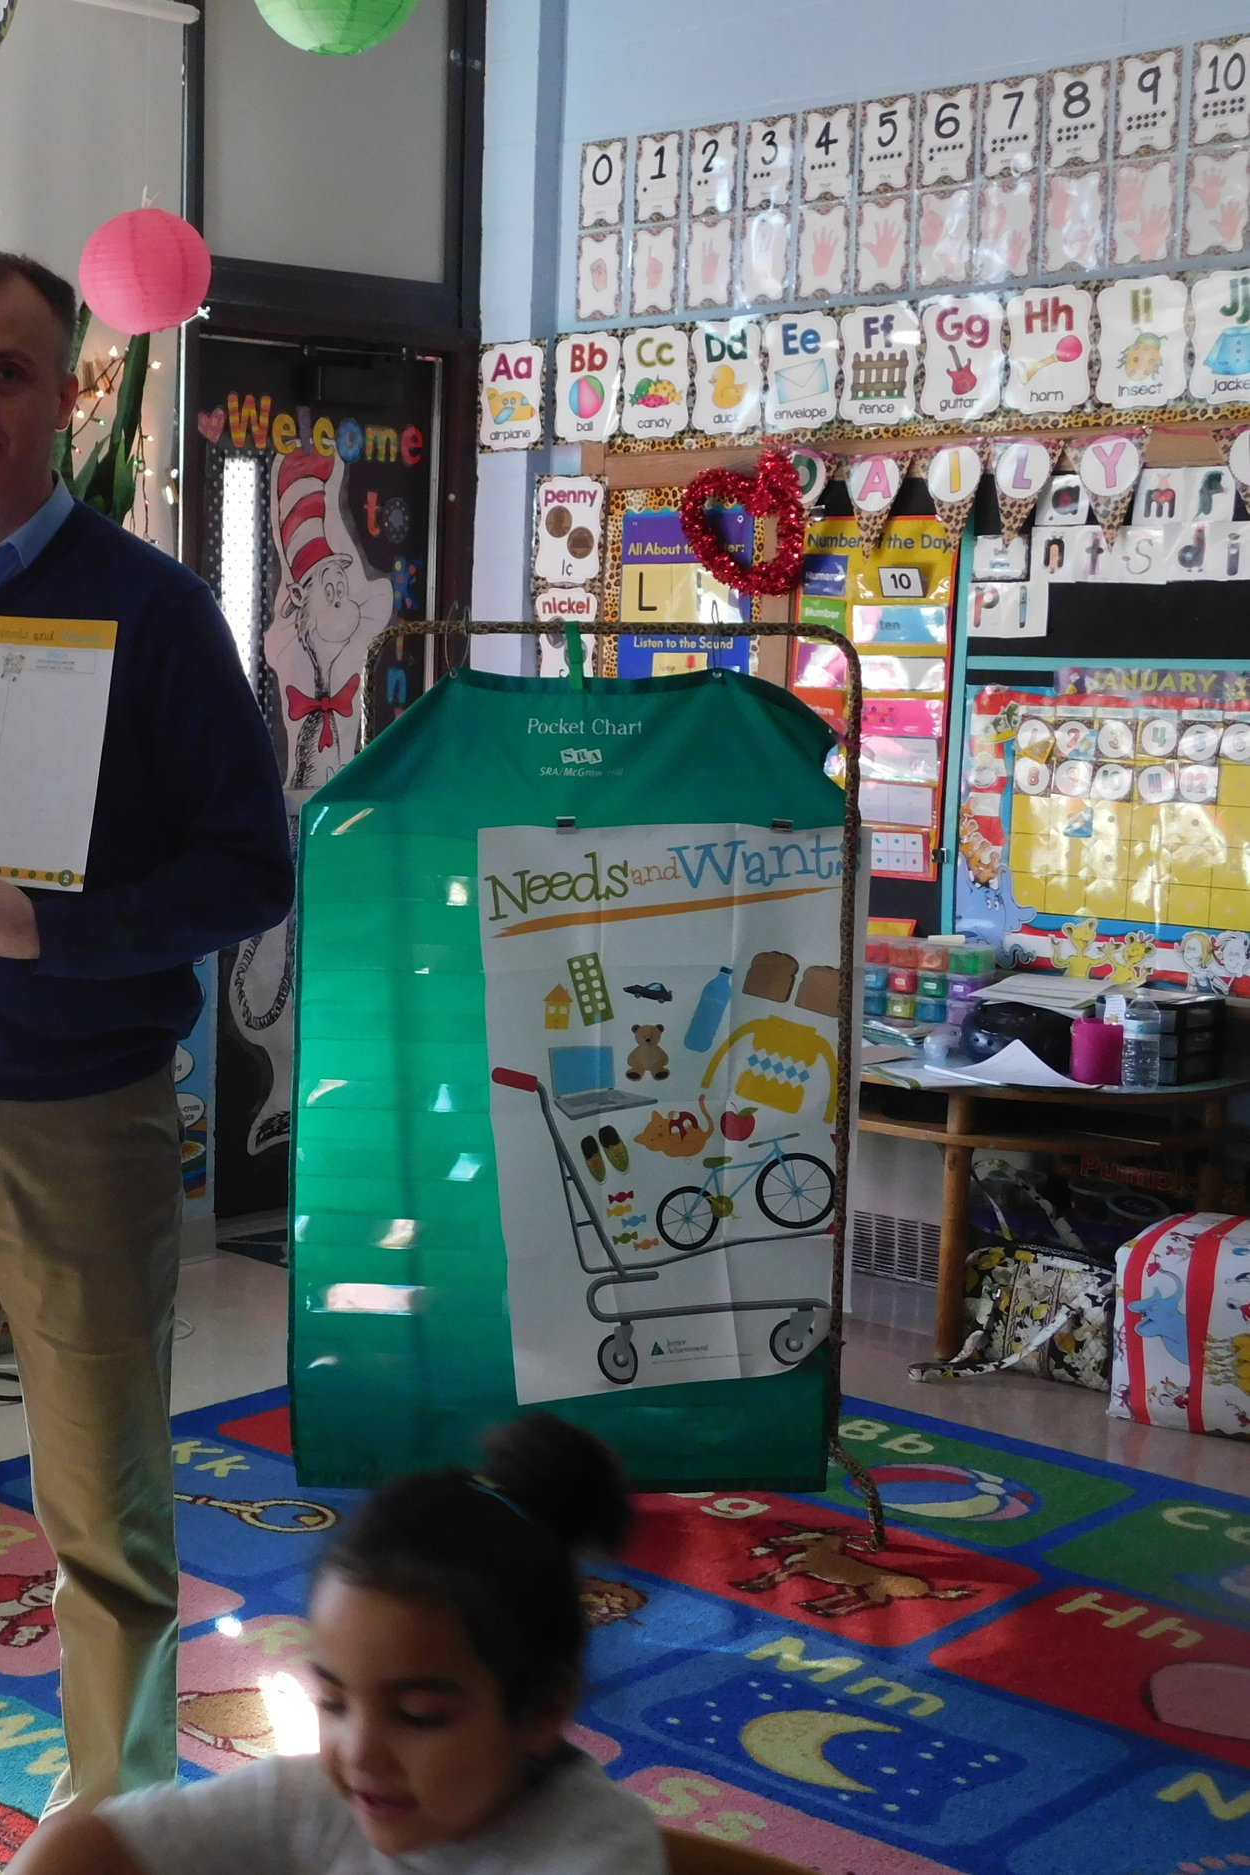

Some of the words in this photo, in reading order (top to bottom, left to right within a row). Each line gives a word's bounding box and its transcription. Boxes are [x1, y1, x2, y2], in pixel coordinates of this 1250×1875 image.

[1137, 66, 1161, 105] 9
[1205, 53, 1246, 95] 10
[1002, 91, 1024, 129] 7
[1062, 81, 1091, 119] 8
[877, 110, 898, 147] 5
[934, 103, 960, 139] 6
[760, 130, 778, 165] 3
[815, 121, 839, 155] 4
[650, 146, 666, 180] 1
[701, 139, 719, 173] 2
[1023, 296, 1074, 334] Hh
[1219, 276, 1250, 324] Jj
[781, 323, 822, 356] Ee
[863, 314, 895, 349] Ff
[935, 306, 990, 349] Gg
[570, 342, 608, 373] Bb
[636, 337, 676, 368] Cc
[704, 329, 748, 363] Dd
[490, 353, 533, 382] Aa
[1029, 388, 1065, 403] horn
[1117, 380, 1164, 398] insect
[1211, 379, 1250, 395] jacke
[773, 406, 827, 422] envelope
[858, 402, 895, 415] fence
[939, 397, 979, 412] guitar
[227, 391, 425, 466] Welcome
[489, 428, 532, 441] airplane
[576, 420, 594, 432] ball
[637, 415, 673, 431] candy
[544, 488, 598, 508] penny
[363, 491, 411, 543] to
[627, 542, 643, 556] All
[644, 542, 681, 556] About
[807, 533, 863, 549] Number
[887, 533, 915, 549] the
[920, 534, 952, 553] Day
[638, 571, 658, 612] L
[890, 573, 912, 590] 10
[542, 597, 591, 615] nickel
[804, 607, 840, 619] Number
[880, 620, 900, 631] ten
[633, 636, 664, 650] Listen
[666, 637, 677, 649] to
[679, 636, 697, 649] the
[699, 636, 734, 650] Sound
[1091, 672, 1218, 694] JANUARY
[527, 717, 585, 735] Pocket
[591, 718, 643, 736] Chart
[561, 748, 602, 764] SRA
[62, 873, 70, 884] 2
[484, 852, 631, 921] Needs
[630, 857, 683, 886] and
[837, 1419, 934, 1455] Bb
[171, 1440, 251, 1477] Kk
[1055, 1591, 1204, 1650] Hh
[746, 1636, 946, 1717] Mm
[653, 1776, 767, 1841] Ss
